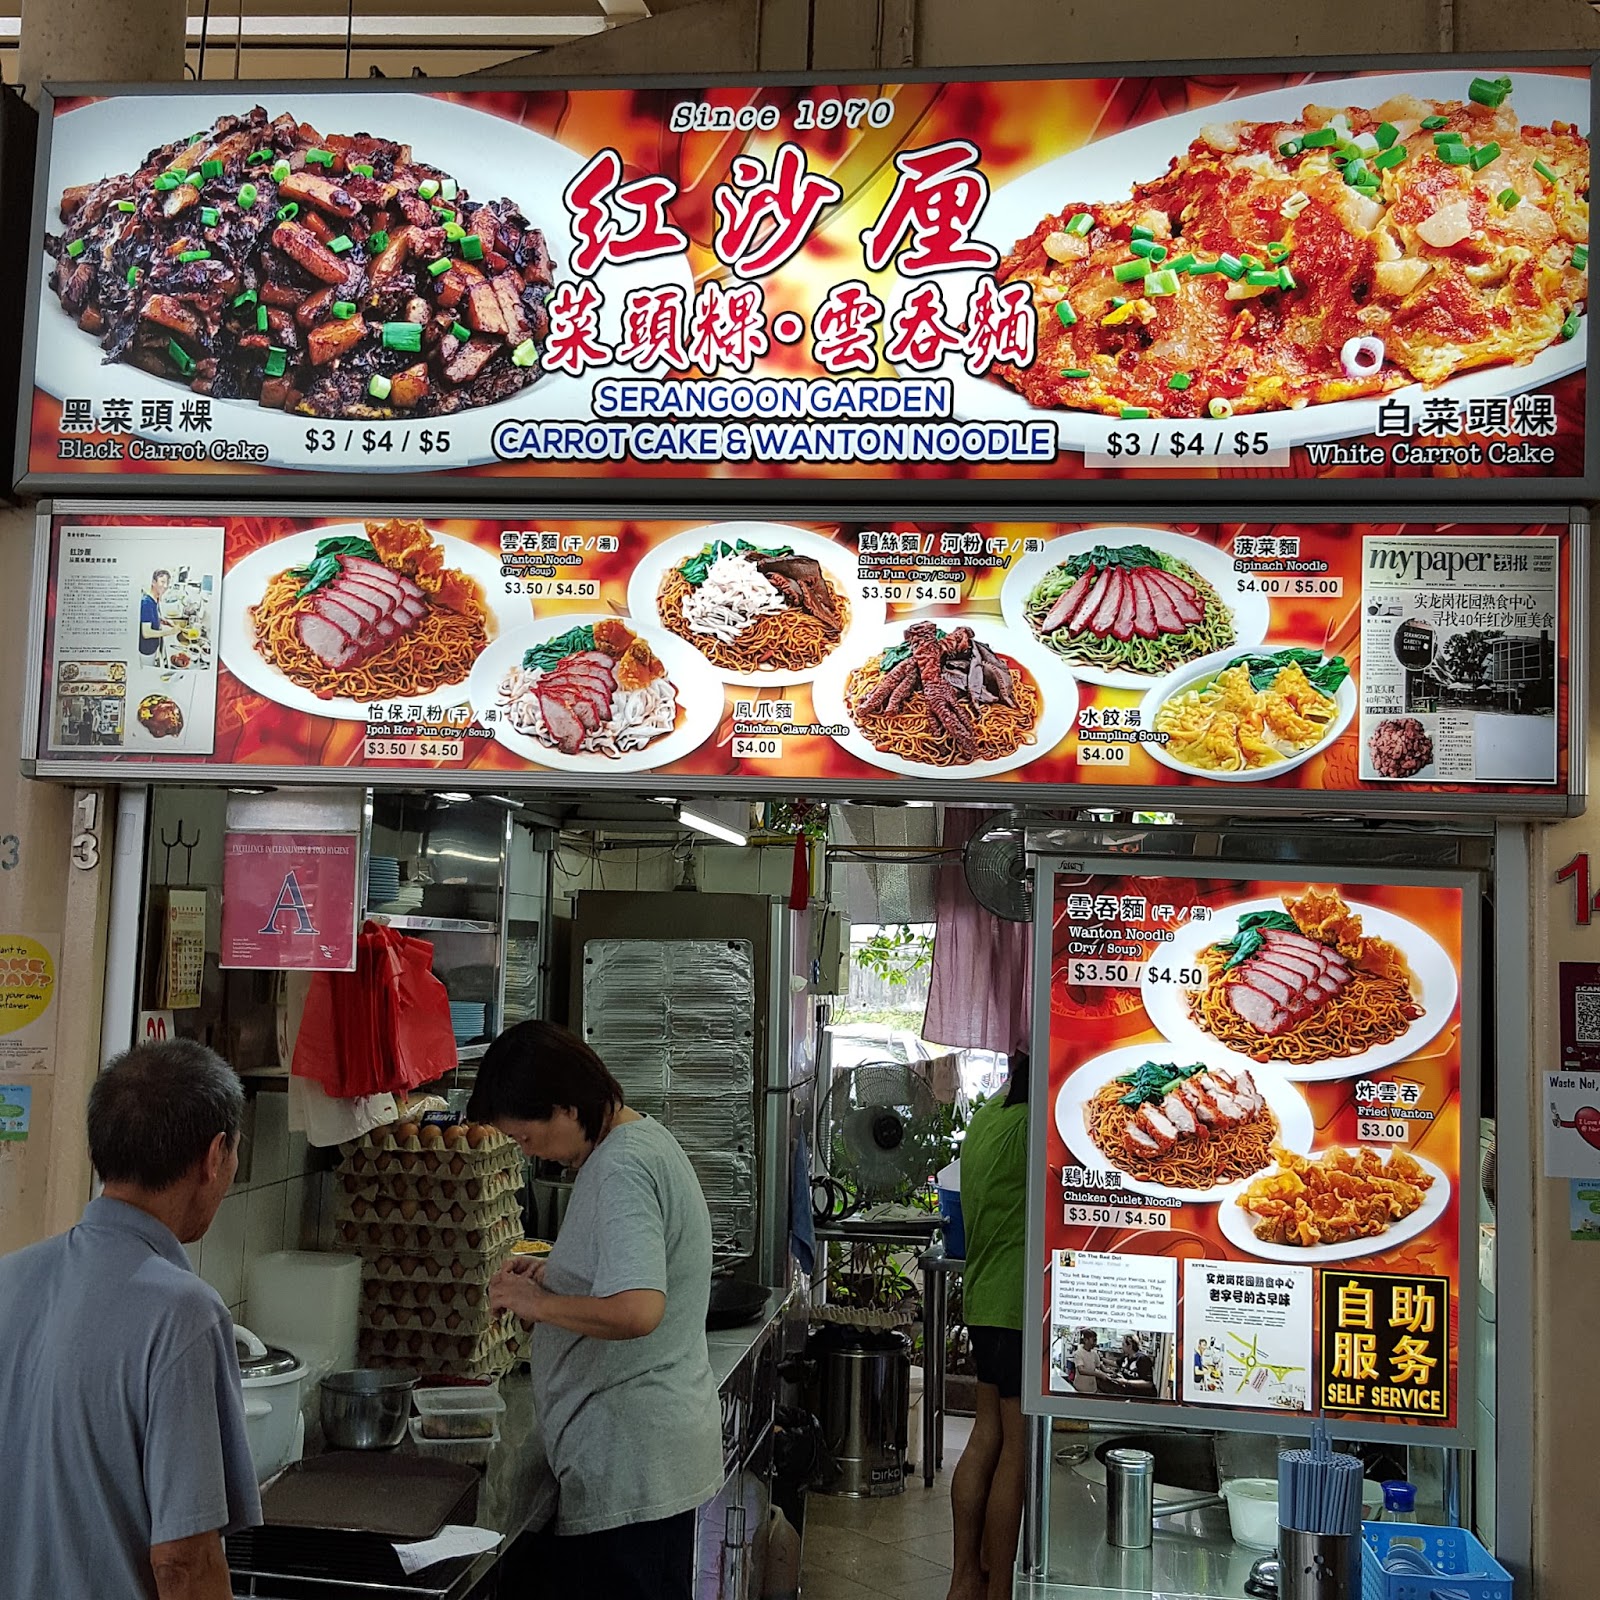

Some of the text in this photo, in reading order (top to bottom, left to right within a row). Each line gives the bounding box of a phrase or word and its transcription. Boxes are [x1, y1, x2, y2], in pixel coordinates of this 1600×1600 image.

[672, 99, 894, 130] Since 1970
[566, 148, 997, 273] 红沙厘
[599, 385, 946, 412] SERANGOON GARDEN
[61, 398, 213, 433] 黑菜頭粿
[1378, 397, 1556, 437] 白菜頭粿
[305, 429, 336, 453] $3
[362, 429, 393, 453] $4
[419, 429, 450, 453] $5
[499, 428, 1050, 455] CARROT CAKE & WANTON NOODLE
[1106, 433, 1141, 458] $3
[1170, 432, 1204, 457] $4
[1233, 431, 1269, 456] $5
[58, 440, 268, 461] Black Carrot Cake
[1305, 444, 1555, 464] White Carrot Cake
[942, 535, 981, 552] 河粉
[502, 554, 582, 565] Wanton Noodle
[859, 556, 913, 566] Shredded
[916, 556, 961, 566] Chicken
[1235, 560, 1328, 572] Spinach Noodle
[858, 569, 881, 579] Hor
[882, 570, 905, 579] Fun
[505, 582, 542, 595] $3.50
[556, 583, 595, 595] $4.50
[862, 587, 902, 600] $3.50
[916, 588, 956, 600] $4.50
[1237, 580, 1280, 592] $4.00
[1295, 580, 1338, 593] $5.00
[1414, 593, 1536, 611] 实龙岗花园熟食中心
[366, 725, 391, 736] Ipoh
[393, 725, 414, 735] Hor
[416, 725, 438, 736] Fun
[734, 724, 850, 736] Chicken Claw Noodle
[1080, 730, 1170, 743] Dumpling Soup
[368, 742, 407, 755] $3.50
[420, 744, 459, 756] $4.50
[737, 741, 776, 753] $4.00
[1082, 748, 1124, 761] $4.00
[1555, 851, 1600, 925] 1
[258, 870, 320, 935] A
[1069, 927, 1175, 941] Wanton Noodle
[0, 946, 27, 955] ant to
[0, 958, 45, 974] AKE
[1074, 964, 1128, 981] $3.50
[1148, 966, 1203, 984] $4.50
[1550, 1076, 1600, 1091] Waste Not,
[1358, 1106, 1434, 1119] Fried Wanton
[1362, 1123, 1405, 1137] $3.00
[1064, 1192, 1182, 1208] Chicken Cutlet Noodle
[1069, 1208, 1110, 1222] $3.50
[1125, 1211, 1166, 1226] $4.50
[1338, 1280, 1435, 1333] 自助
[1332, 1332, 1437, 1385] 服务
[1328, 1383, 1440, 1411] SELF SERVICE
